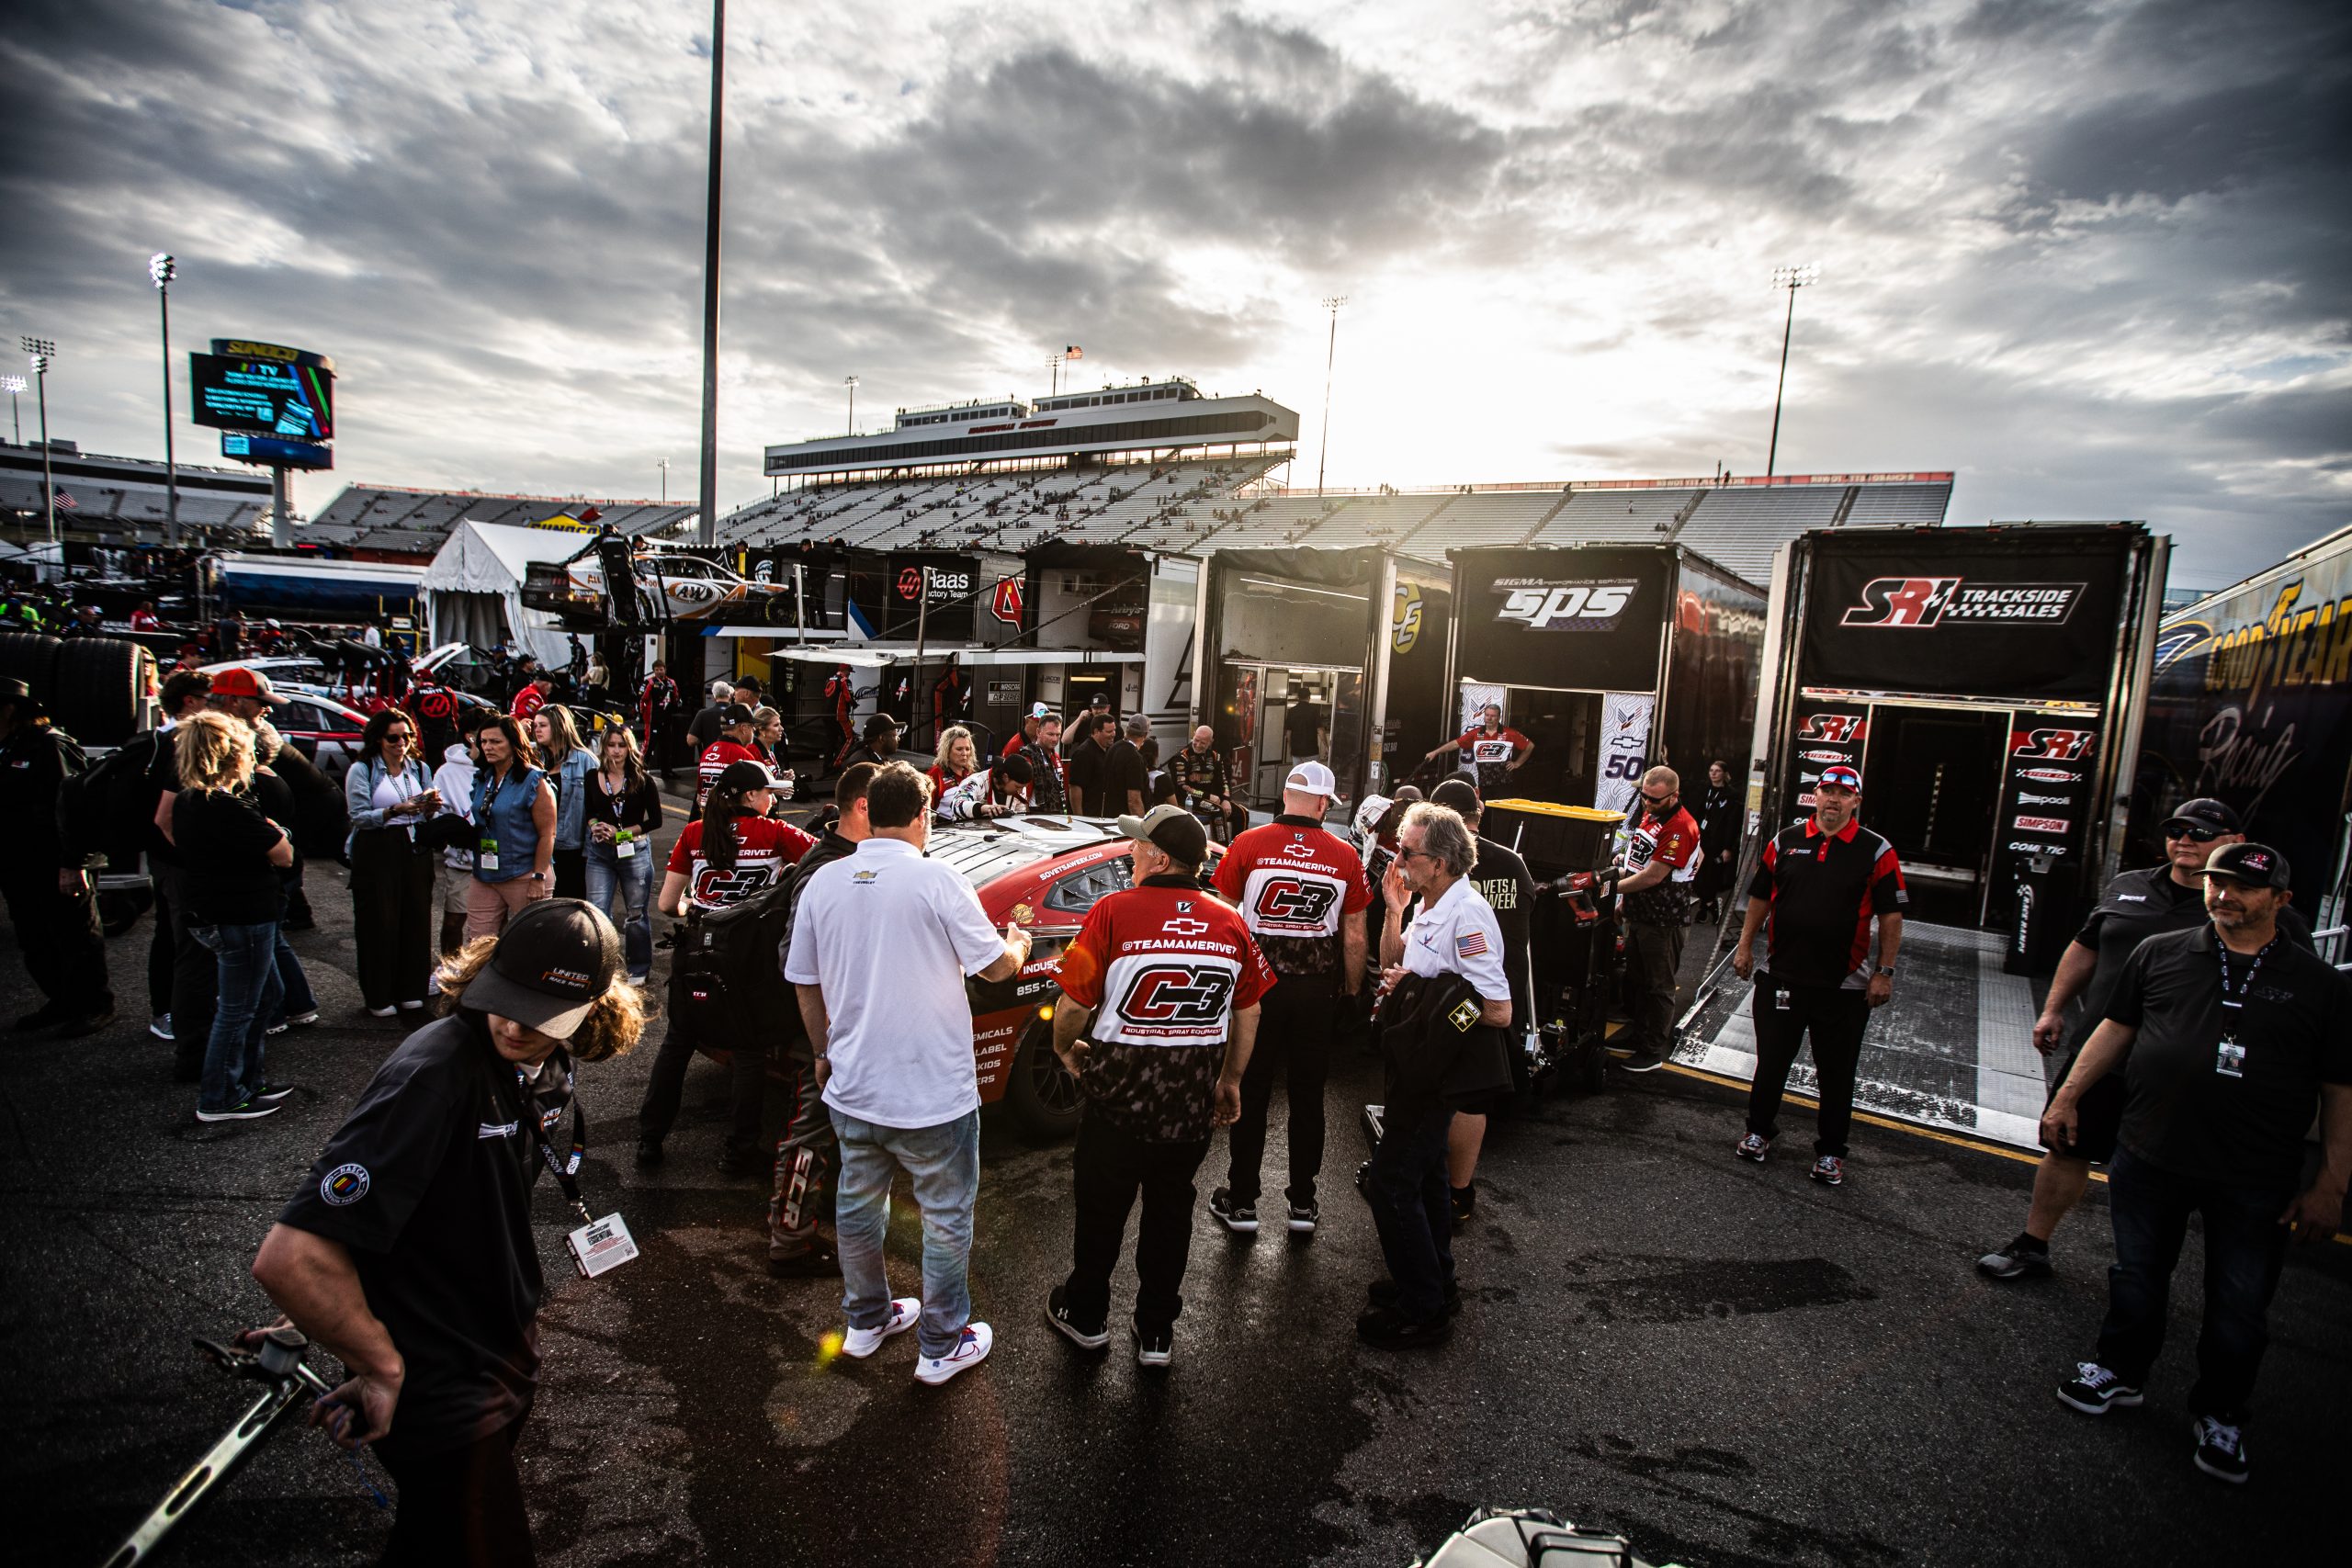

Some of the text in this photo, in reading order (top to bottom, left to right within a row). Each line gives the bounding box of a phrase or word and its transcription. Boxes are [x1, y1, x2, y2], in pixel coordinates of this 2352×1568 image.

[258, 363, 279, 376] TV
[1493, 578, 1544, 586] SIGMA
[928, 591, 947, 599] actory
[1839, 577, 2073, 626] SRI TRACKSIDE
[1999, 604, 2065, 618] SALES
[1109, 622, 1130, 630] FORD
[1798, 714, 1861, 743] SRI
[2013, 728, 2094, 761] SRI
[1605, 754, 1645, 781] 50
[2017, 818, 2064, 830] SIMPSON
[2008, 841, 2068, 855] COMTIC
[1257, 857, 1338, 874] @TEAMAMERIVET
[695, 865, 774, 904] C3
[1483, 878, 1517, 894] VETS A
[1254, 876, 1339, 924] C3
[553, 967, 589, 981] UNITED
[1023, 957, 1060, 975] INDUST
[1116, 964, 1236, 1025] C3
[972, 1026, 1013, 1042] EMICALS
[975, 1043, 1007, 1056] LABEL
[977, 1075, 996, 1086] ERS
[340, 1166, 368, 1183] NASCAR
